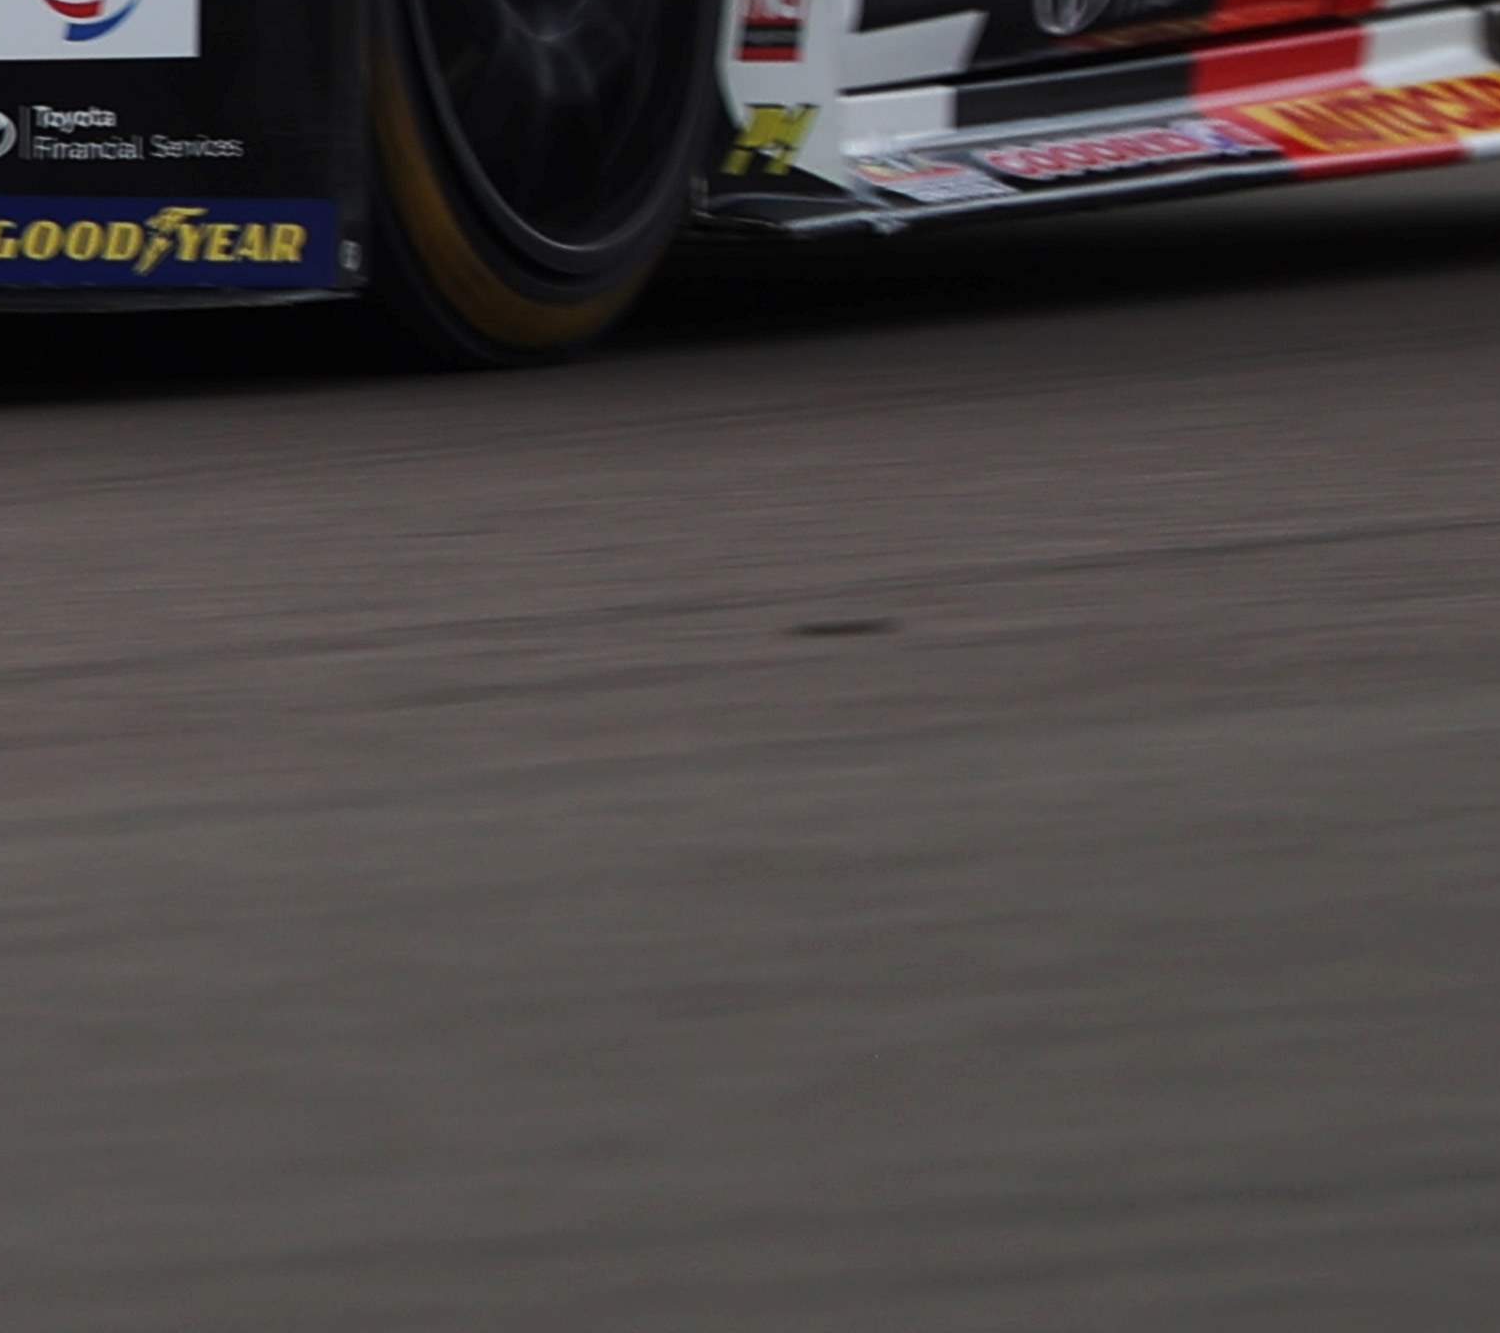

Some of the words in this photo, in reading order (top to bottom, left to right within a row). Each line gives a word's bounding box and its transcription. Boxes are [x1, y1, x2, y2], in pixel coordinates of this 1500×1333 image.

[33, 104, 117, 133] Toyota
[33, 134, 145, 161] Financial
[150, 134, 245, 161] Services
